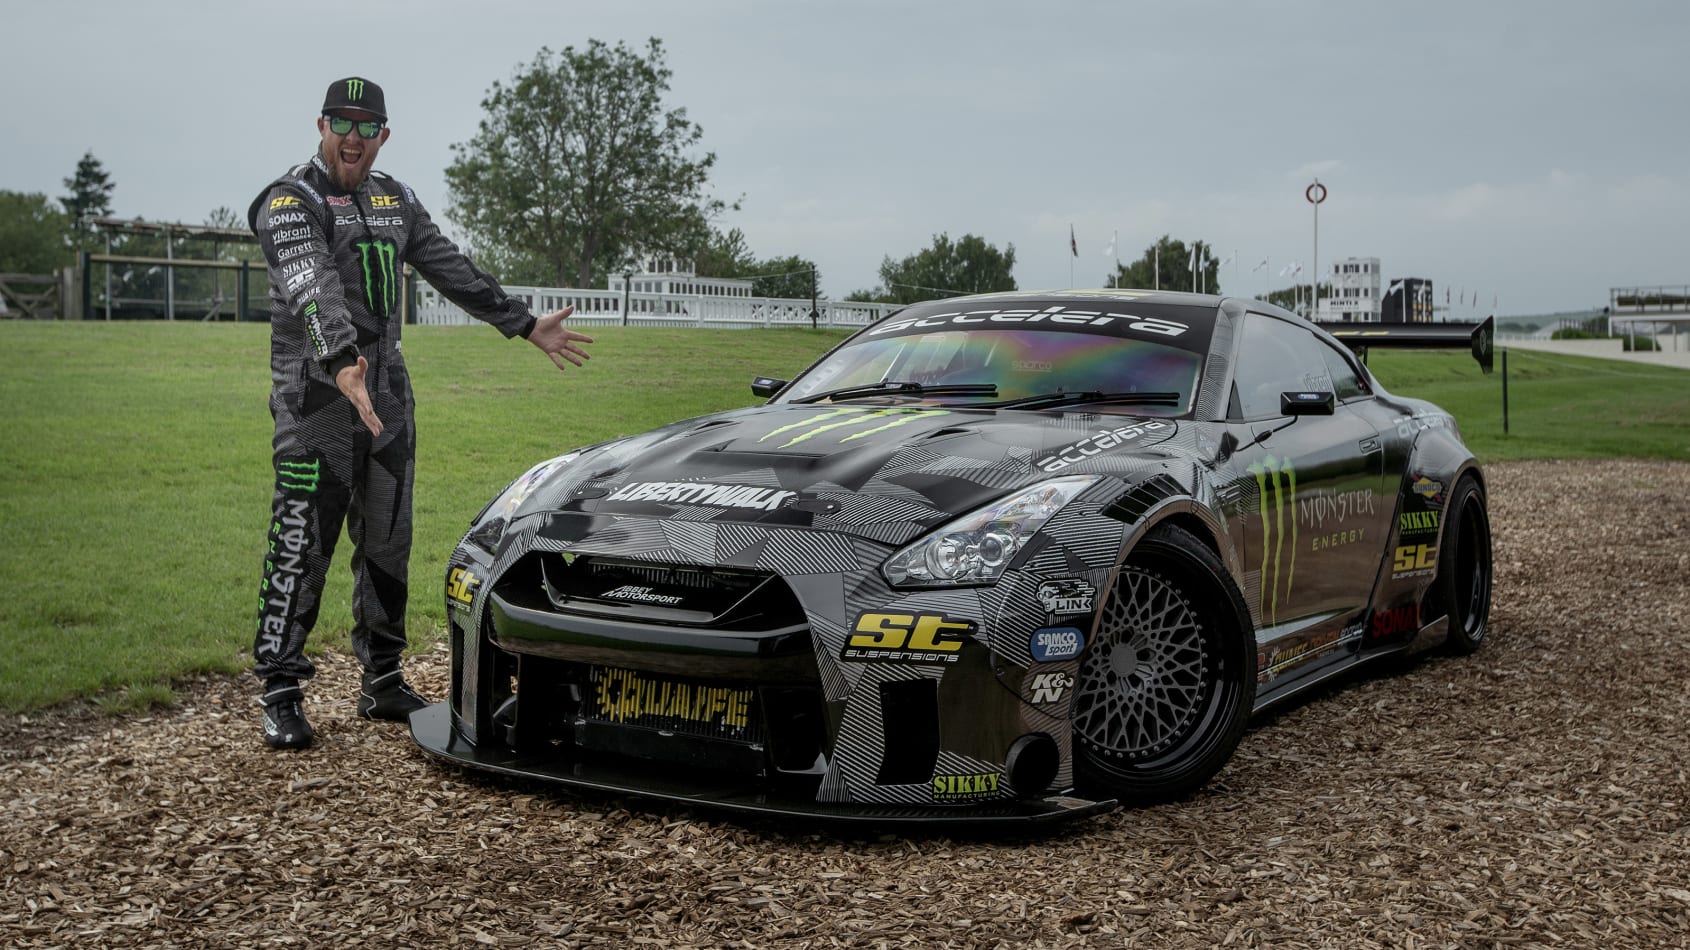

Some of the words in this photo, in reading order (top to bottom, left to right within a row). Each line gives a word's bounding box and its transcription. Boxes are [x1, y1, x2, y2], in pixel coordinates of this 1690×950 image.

[268, 212, 306, 228] SONAX
[272, 224, 311, 241] vibrant
[277, 241, 313, 259] Garrett
[282, 256, 316, 275] SIKKY
[869, 306, 1190, 337] accelera
[1012, 360, 1053, 372] sparco
[1036, 420, 1167, 473] accelera
[606, 482, 797, 511] LIBERTYWALK
[1400, 511, 1439, 530] SIKKY
[1312, 528, 1366, 551] ENERGY
[256, 521, 282, 631] ENERGY
[601, 590, 683, 604] MOTORSPORT
[614, 585, 653, 594] ABBEY
[1055, 599, 1091, 611] LINK
[1037, 632, 1077, 647] SAMCO
[844, 650, 960, 662] SUSPENSIONS
[1045, 642, 1078, 656] sport
[933, 772, 1001, 794] SIKKY
[933, 789, 1001, 800] MANUFACTURING
